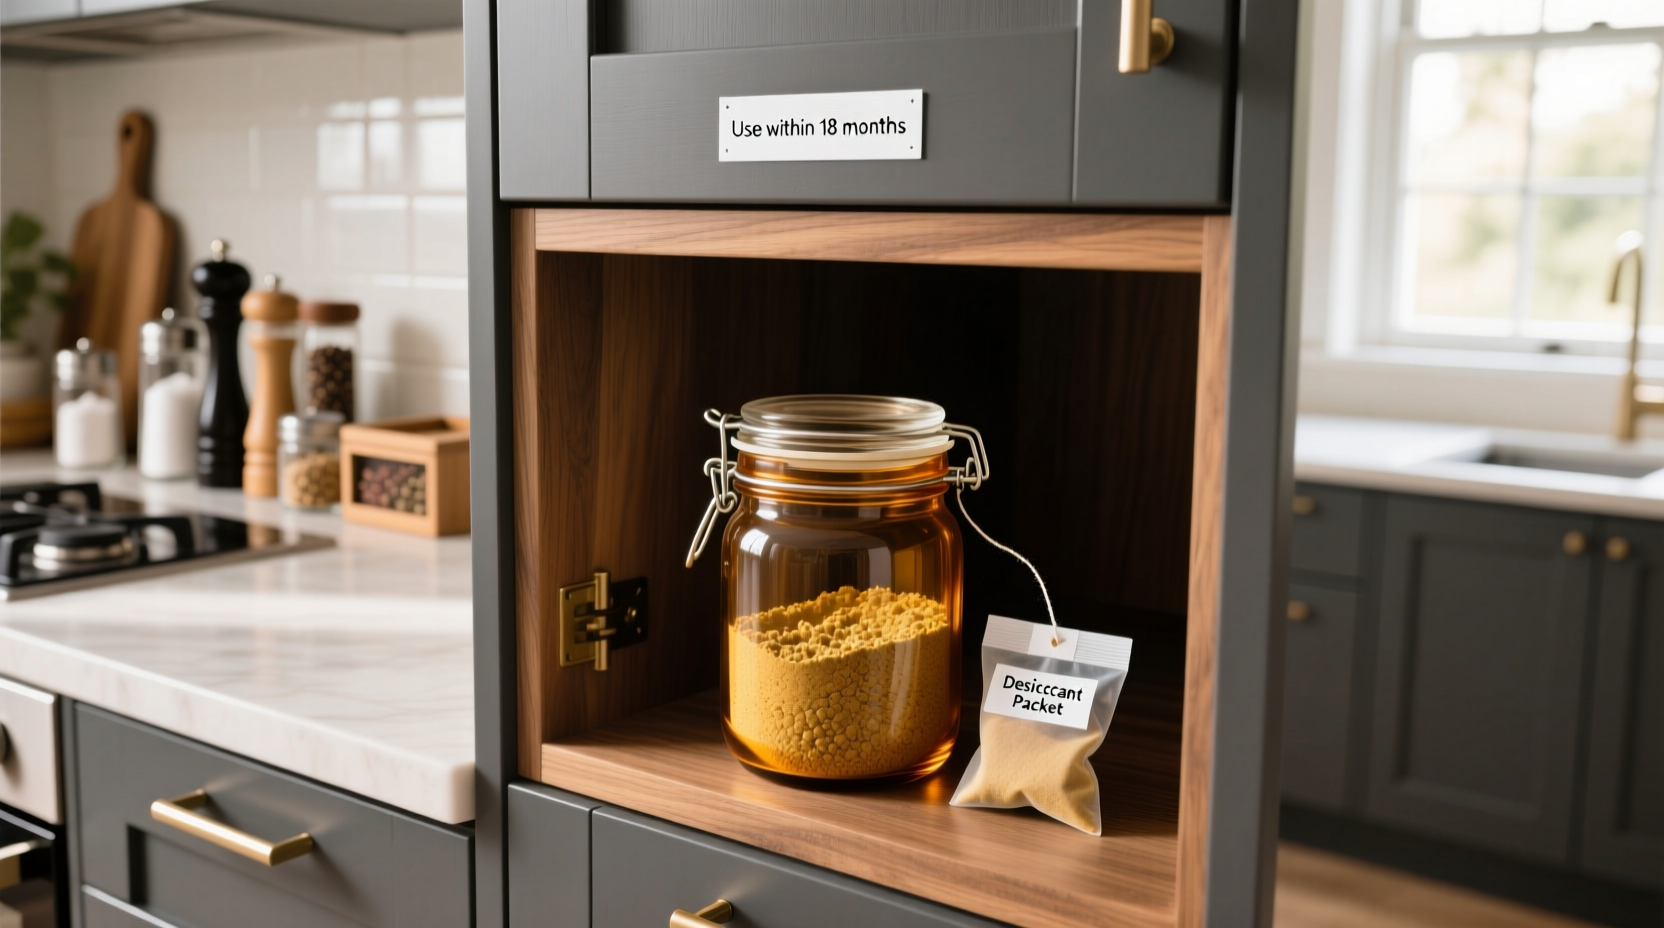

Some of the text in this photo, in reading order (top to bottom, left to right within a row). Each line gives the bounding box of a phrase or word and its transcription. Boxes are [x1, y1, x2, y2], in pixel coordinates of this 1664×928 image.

[732, 116, 907, 138] Use within 18 months
[1012, 694, 1064, 716] Packet
